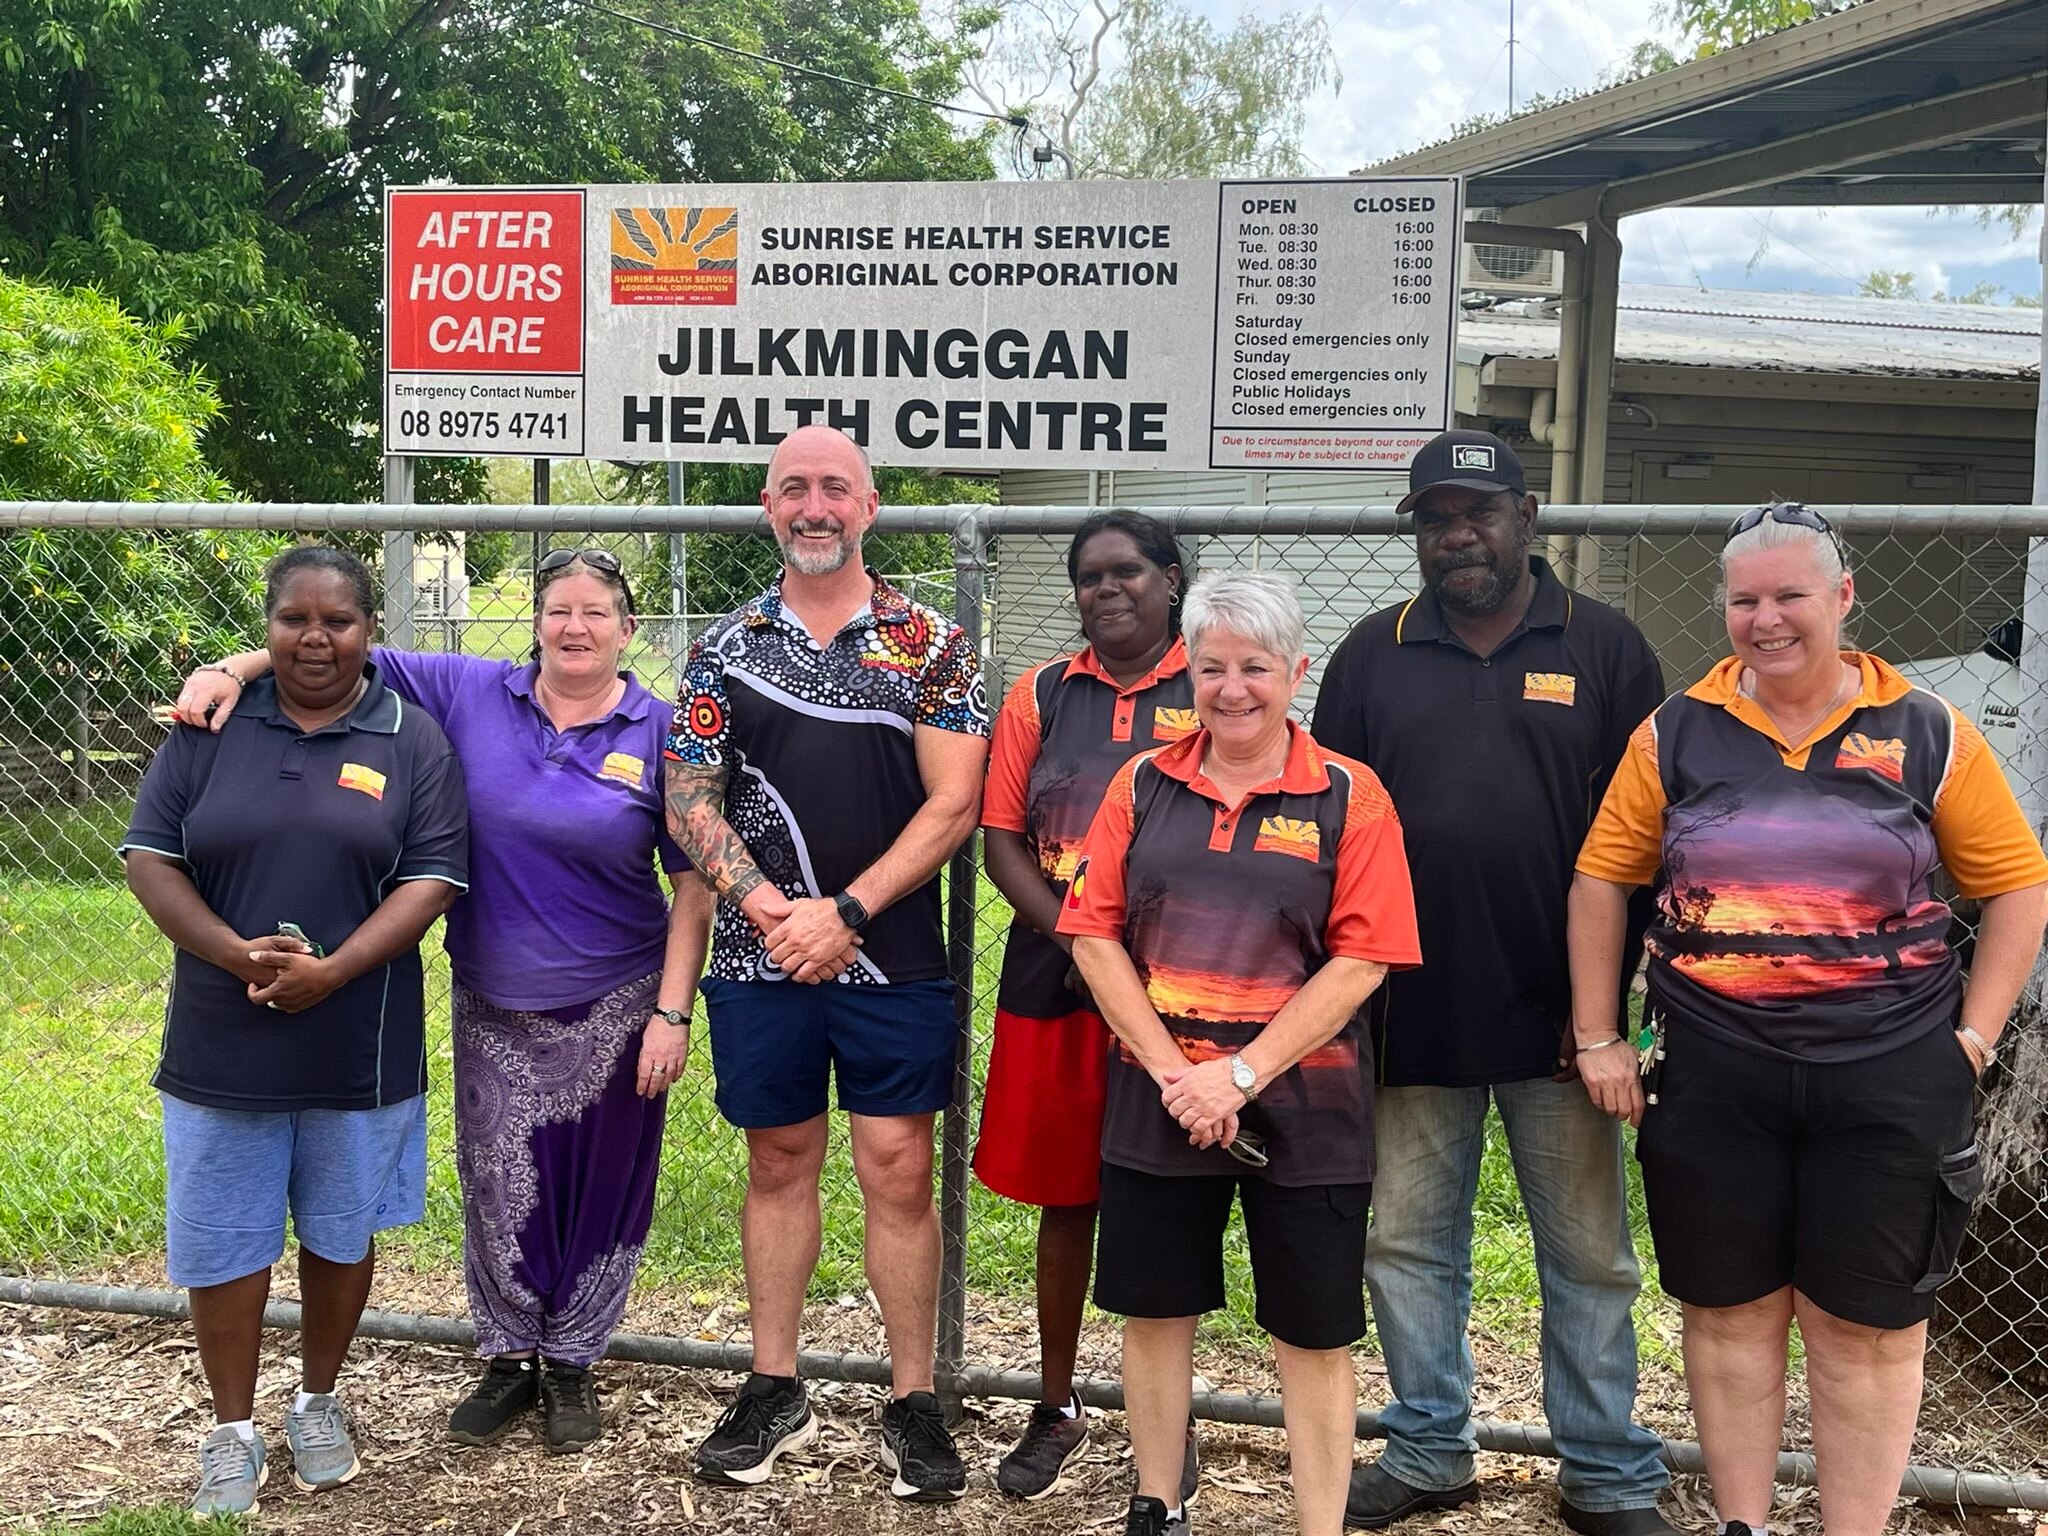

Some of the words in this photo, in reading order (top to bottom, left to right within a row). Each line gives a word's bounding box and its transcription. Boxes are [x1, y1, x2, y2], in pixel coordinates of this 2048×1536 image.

[1242, 200, 1296, 214] OPEN
[1354, 198, 1435, 213] CLOSED
[417, 212, 552, 248] AFTER
[1240, 224, 1273, 235] Mon.
[1280, 223, 1318, 235] 08:30
[1396, 222, 1434, 234] 16:00
[762, 227, 893, 250] SUNRISE
[905, 227, 1022, 249] HEALTH
[1034, 225, 1170, 249] SERVICE
[1238, 241, 1267, 253] Tue.
[1279, 241, 1317, 252] 08:30
[1395, 240, 1433, 251] 16:00
[1238, 259, 1272, 270] Wed.
[1278, 259, 1316, 270] 08:30
[1394, 257, 1432, 269] 16:00
[410, 263, 563, 301] HOURS
[614, 275, 654, 284] SUNRISE
[656, 275, 692, 284] HEALTH
[694, 275, 735, 284] SERVICE
[752, 263, 938, 286] ABORIGINAL
[949, 262, 1177, 286] CORPORATION
[1237, 276, 1271, 287] Thur.
[1277, 276, 1316, 287] 08:30
[1393, 275, 1431, 286] 16:00
[620, 284, 669, 292] ABORIGINAL
[670, 284, 729, 292] CORPORATION
[1237, 293, 1257, 304] Fri.
[1277, 293, 1315, 305] 09:30
[1392, 293, 1430, 304] 16:00
[1236, 315, 1302, 331] Saturday
[429, 316, 544, 353] CARE
[1235, 333, 1287, 345] Closed
[1293, 333, 1391, 349] emergencies
[1397, 333, 1429, 348] only
[658, 328, 1128, 379] JILKMINGGAN
[1234, 350, 1290, 366] Sunday
[1234, 368, 1285, 380] Closed
[1291, 369, 1389, 384] emergencies
[1395, 368, 1427, 384] only
[395, 384, 466, 400] Emergency
[471, 386, 520, 397] Contact
[525, 387, 576, 398] Number
[1233, 386, 1279, 397] Public
[1285, 386, 1350, 401] Holidays
[1232, 403, 1284, 415] Closed
[1290, 404, 1387, 419] emergencies
[1393, 404, 1425, 419] only
[401, 410, 429, 436] 08
[439, 411, 499, 438] 8975
[509, 413, 566, 439] 4741
[895, 399, 1167, 451] CENTRE
[1245, 437, 1256, 446] to
[1258, 437, 1332, 447] circumstances
[1334, 437, 1374, 449] beyond
[1376, 439, 1394, 448] our
[1244, 450, 1272, 459] times
[1274, 451, 1296, 461] may
[1298, 450, 1311, 460] be
[1313, 450, 1352, 462] subject
[1354, 451, 1365, 460] to
